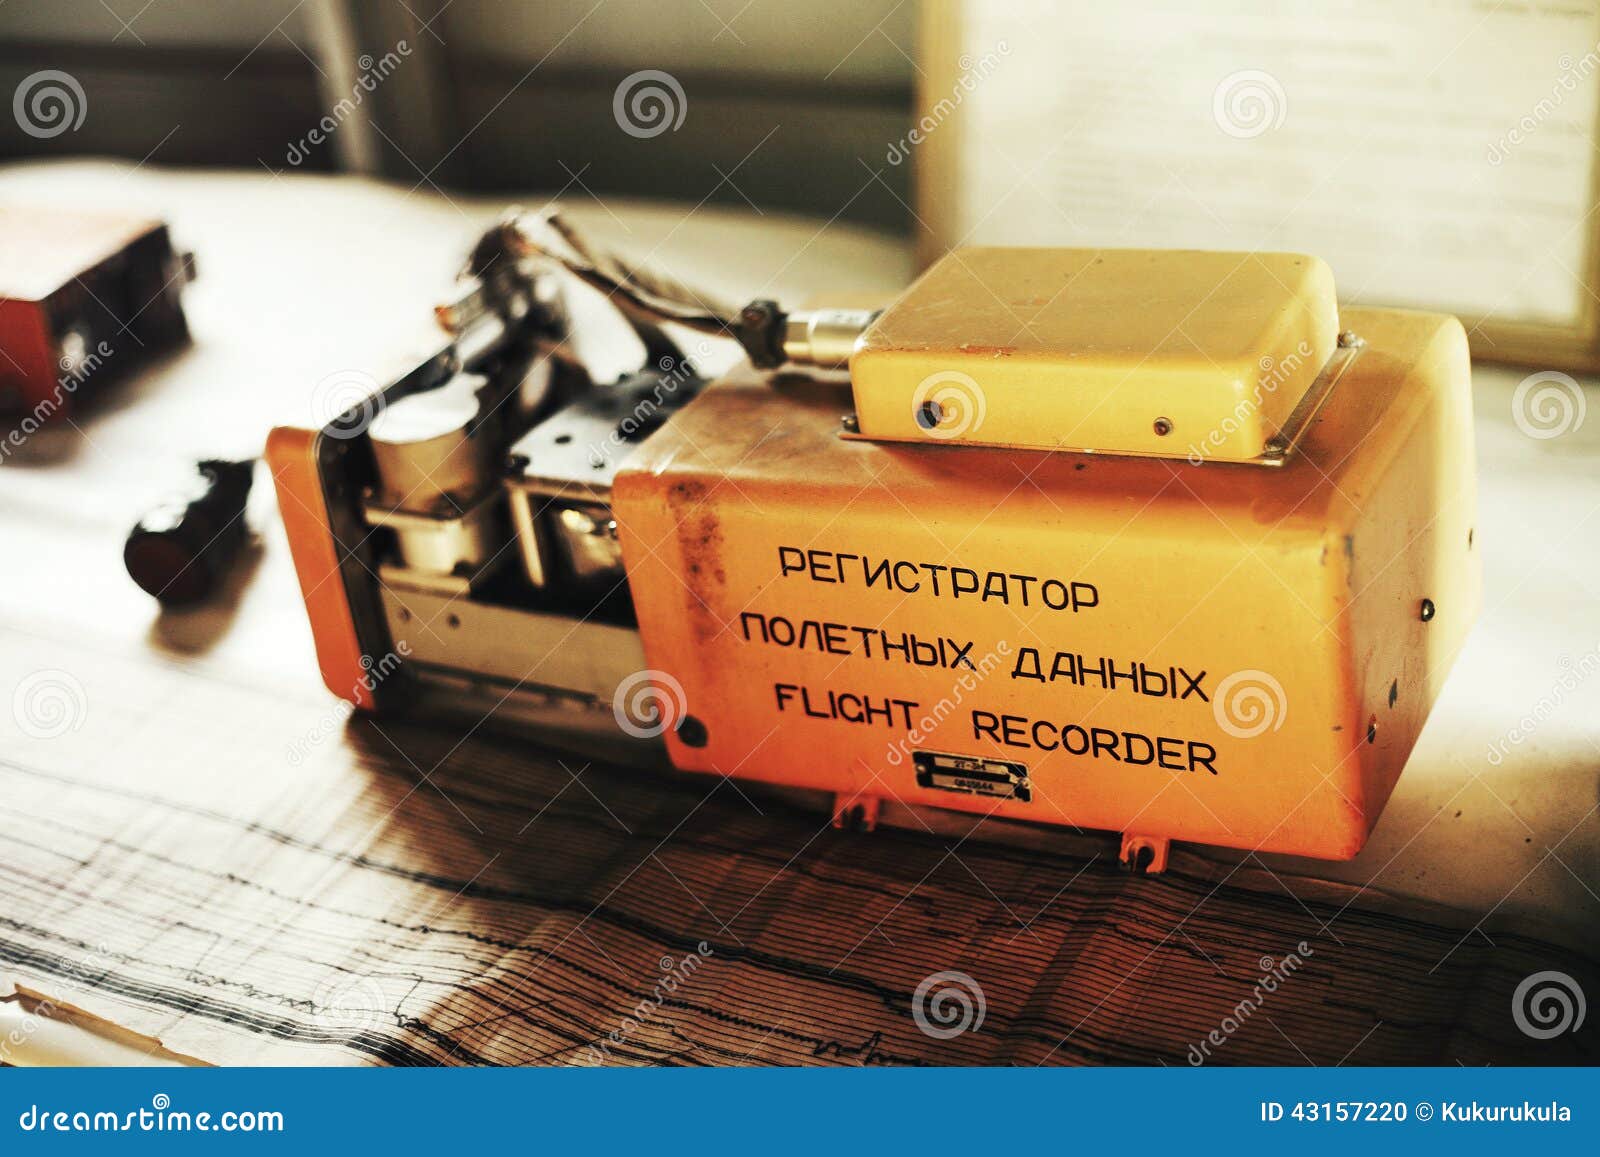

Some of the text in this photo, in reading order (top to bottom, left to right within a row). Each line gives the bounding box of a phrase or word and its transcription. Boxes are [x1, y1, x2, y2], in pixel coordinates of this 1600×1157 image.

[778, 546, 1099, 613] РЕГИСТРАТОР
[740, 612, 1209, 702] ПОЛЕТНЫХ ДАННЫХ
[775, 683, 1218, 775] FLIGHT RECORDER
